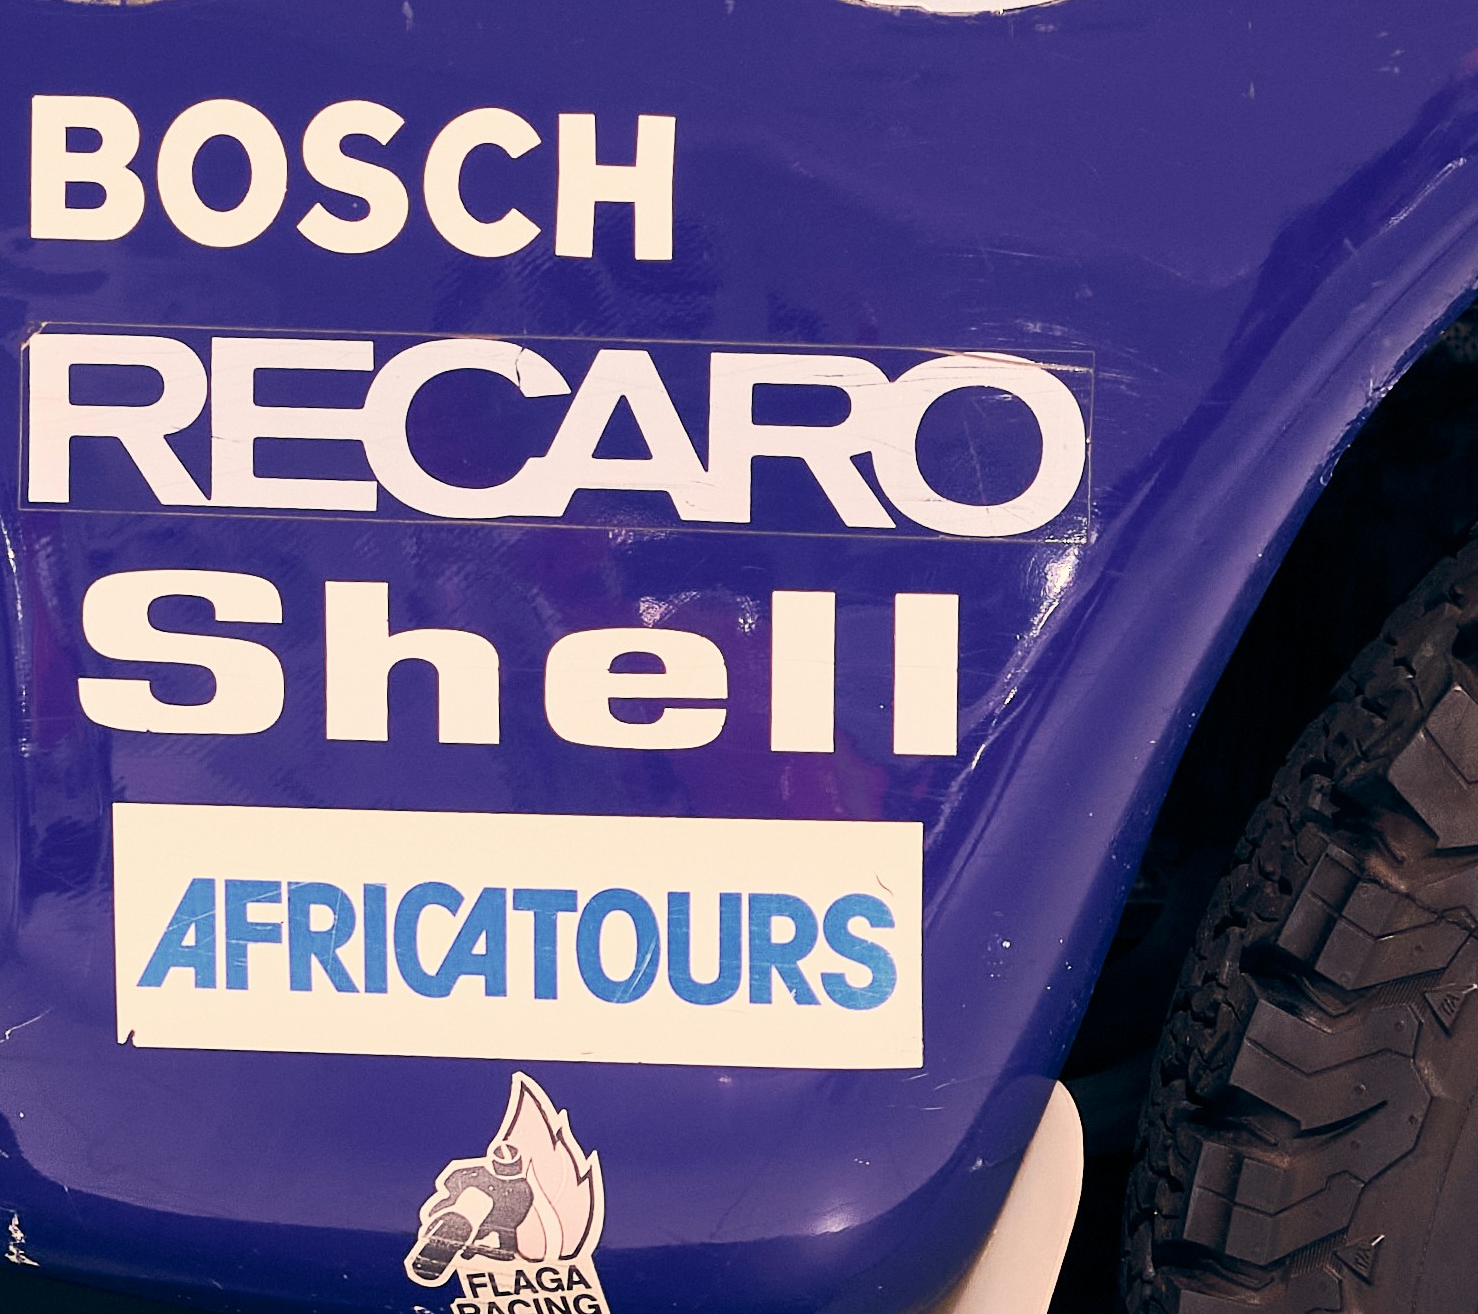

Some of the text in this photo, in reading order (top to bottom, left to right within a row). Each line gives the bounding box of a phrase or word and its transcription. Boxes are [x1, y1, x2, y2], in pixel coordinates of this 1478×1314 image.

[30, 94, 676, 261] BOSCH
[28, 331, 1088, 539] RECARO
[77, 567, 959, 757] Shell
[137, 877, 896, 1011] AFRICATOURS
[466, 1267, 592, 1300] FLAGA
